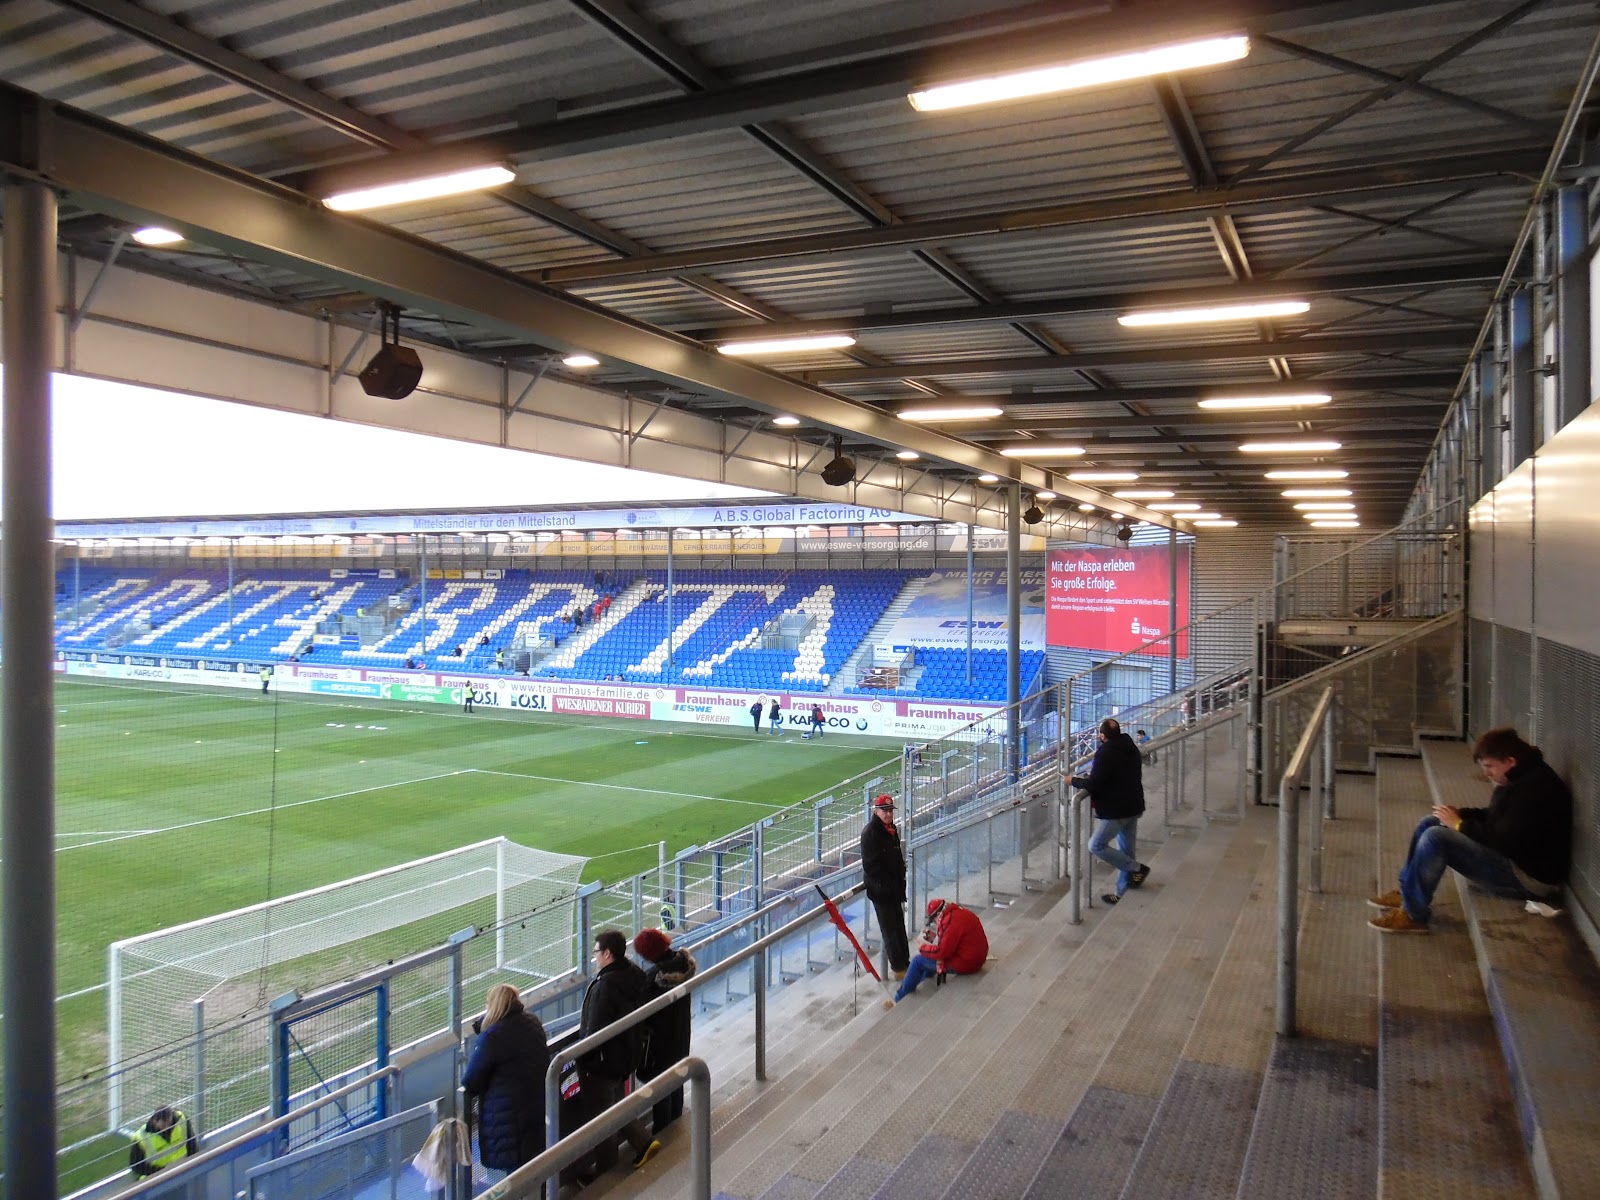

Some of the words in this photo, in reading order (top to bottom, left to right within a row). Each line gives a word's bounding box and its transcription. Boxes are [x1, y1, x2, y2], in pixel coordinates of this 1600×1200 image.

[479, 517, 494, 528] für
[496, 516, 515, 527] den
[518, 514, 576, 527] Mittelstand
[799, 507, 865, 522] Factoring
[869, 507, 892, 518] AG
[800, 539, 929, 551] www.eswe-versorgung.de
[1051, 561, 1063, 572] Mit
[1064, 561, 1077, 572] der
[1078, 561, 1101, 574] Naspa
[1103, 559, 1135, 572] erleben
[1051, 577, 1062, 589] Sie
[1063, 577, 1085, 591] große
[1086, 577, 1117, 592] Erfolge.
[1141, 626, 1160, 637] Naspa
[206, 660, 231, 671] bulthaup
[511, 682, 650, 700] www.traumhaus-familie.de
[556, 697, 613, 713] WIESBADENER
[615, 701, 646, 715] KURIER
[679, 704, 713, 713] ESWE
[695, 713, 731, 723] VERKEHR
